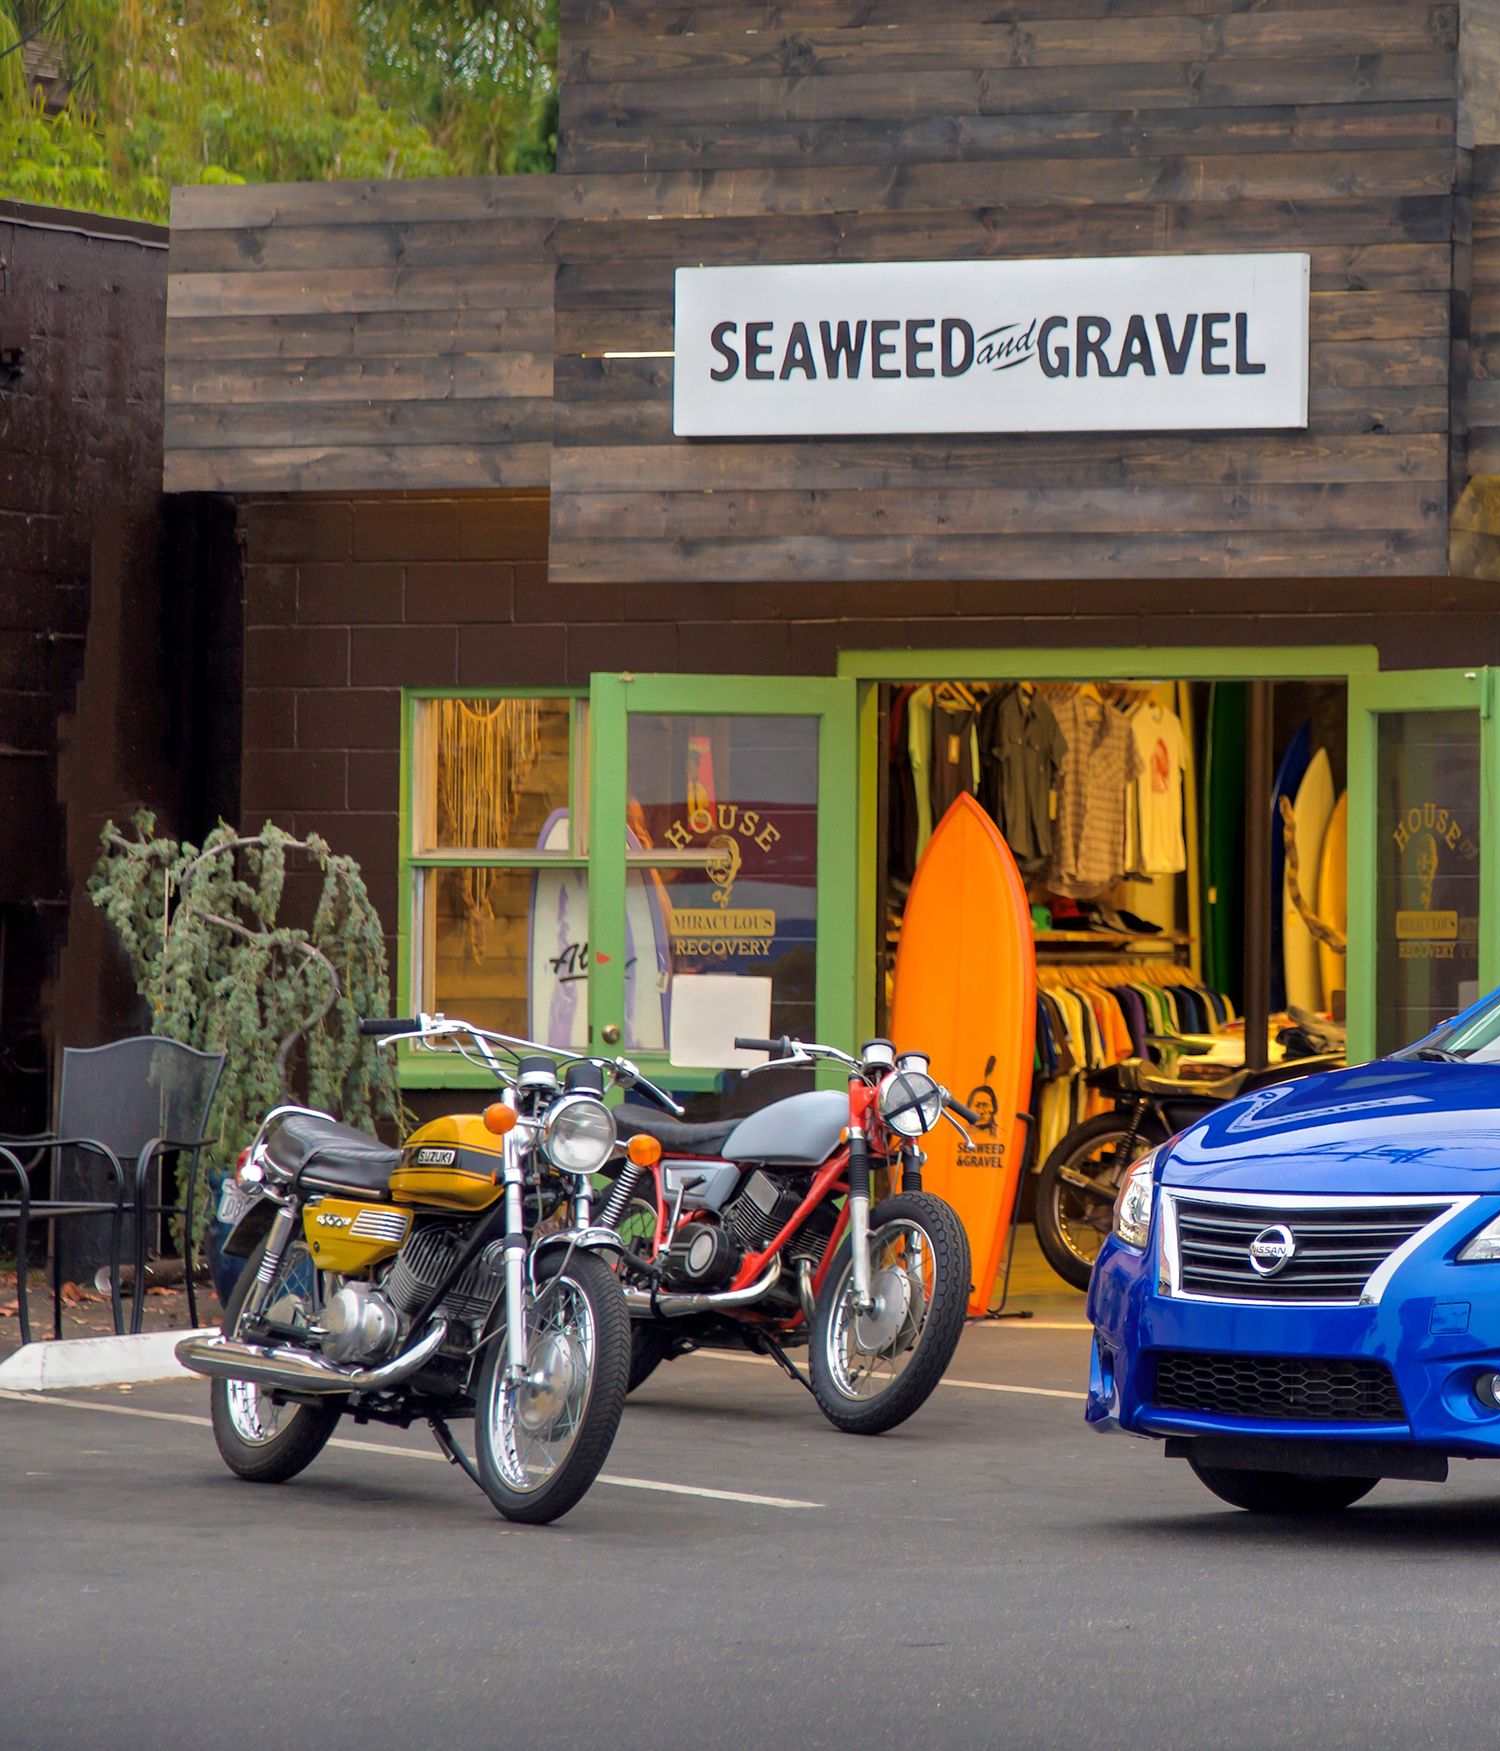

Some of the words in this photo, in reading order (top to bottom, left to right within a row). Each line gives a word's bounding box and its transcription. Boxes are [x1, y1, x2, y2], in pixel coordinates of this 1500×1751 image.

[709, 318, 975, 381] SEAWEED
[975, 318, 1037, 368] and
[1036, 311, 1267, 379] GRAVEL
[664, 804, 782, 853] HOUSE
[1393, 803, 1462, 851] HOUSE
[674, 914, 773, 931] MIRACULOUS
[674, 938, 773, 957] RECOVERY
[419, 1151, 453, 1163] SUZUKI
[957, 1143, 1005, 1155] SEWEED
[1251, 1244, 1287, 1255] NISSAN
